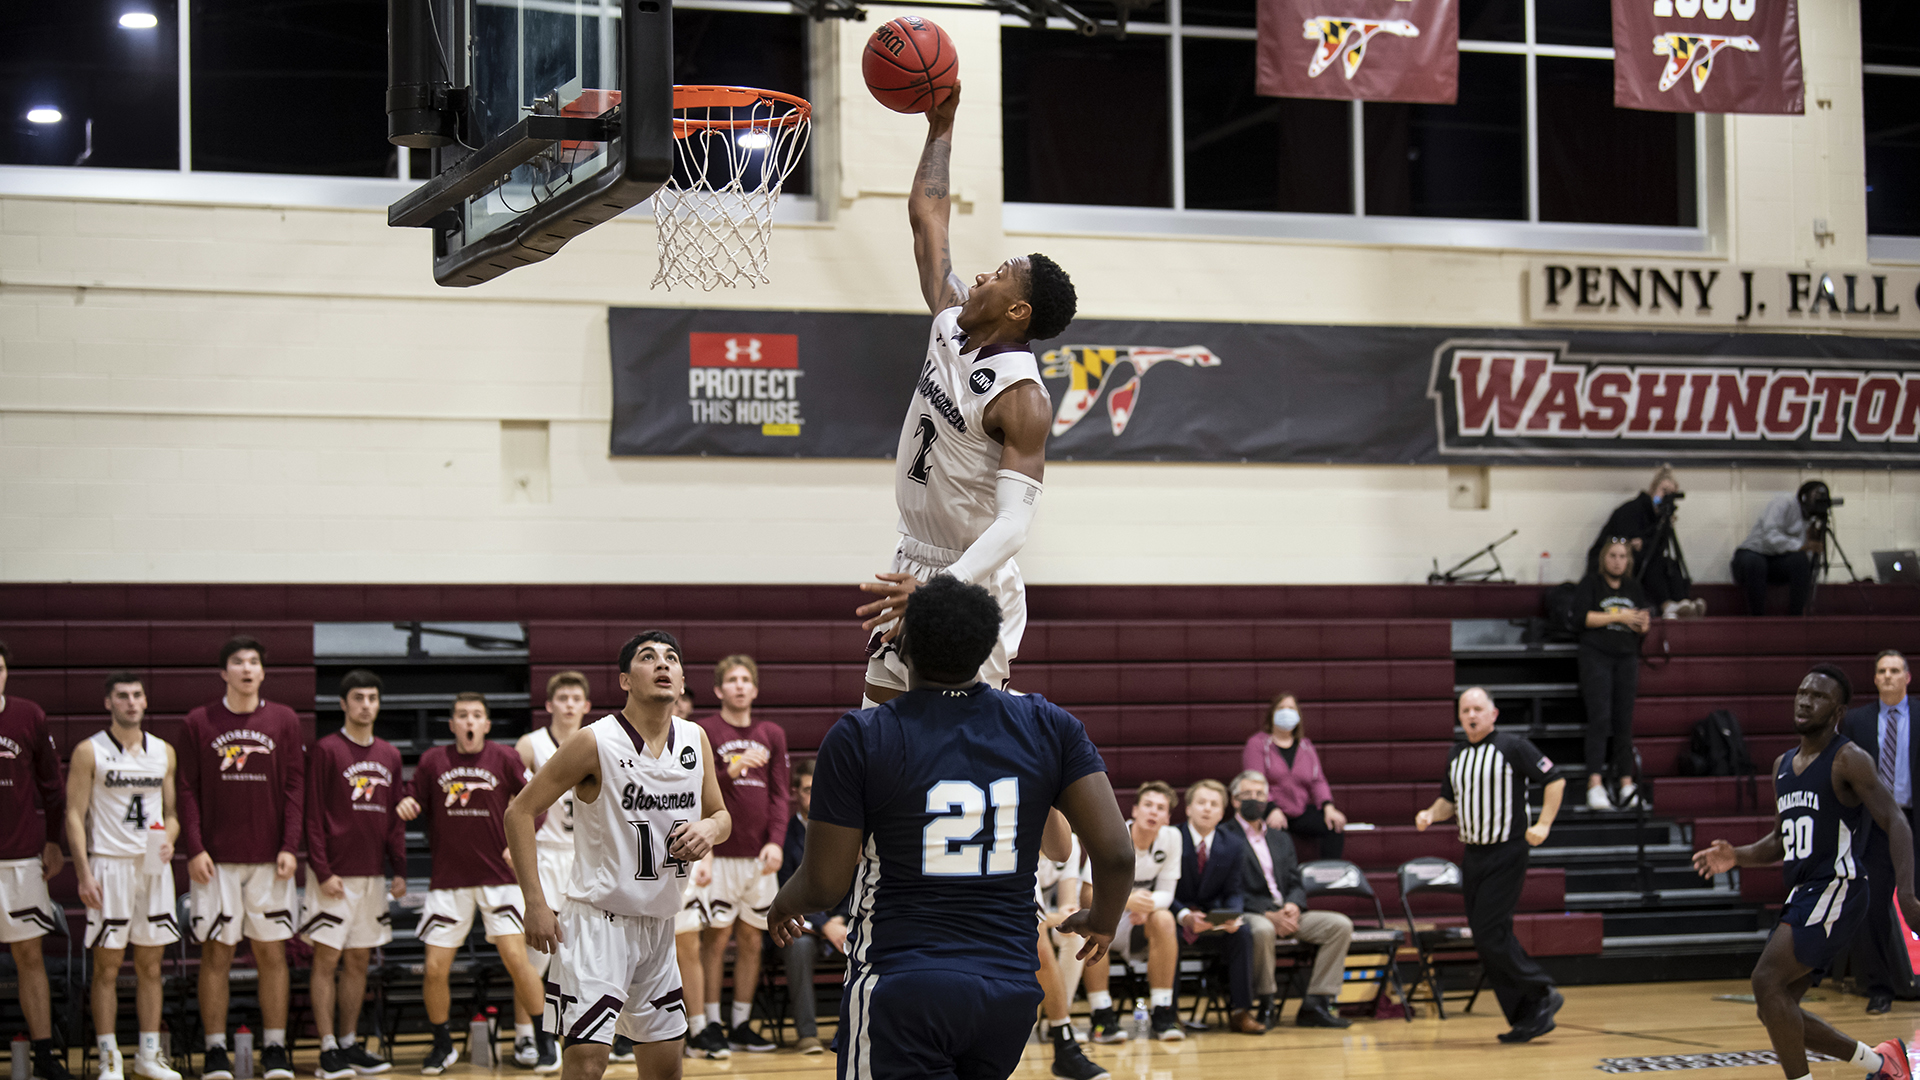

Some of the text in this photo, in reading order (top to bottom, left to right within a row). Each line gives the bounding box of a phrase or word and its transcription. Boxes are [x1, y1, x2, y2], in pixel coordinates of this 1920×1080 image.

[876, 25, 906, 58] Wil
[1545, 265, 1720, 310] PENNY
[1736, 271, 1766, 321] J.
[1786, 271, 1899, 315] FALL
[689, 368, 799, 399] PROTECT
[917, 359, 968, 434] Shoremen
[972, 371, 994, 391] JNW
[689, 400, 733, 424] THIS
[907, 413, 939, 487] 2
[210, 729, 276, 751] SHOREMEN
[717, 739, 770, 760] SHOREMN
[437, 766, 499, 788] SHOREMEN
[123, 793, 150, 832] 4
[621, 782, 697, 812] Shoremen
[922, 776, 1020, 877] 21
[1781, 815, 1815, 862] 20
[626, 819, 690, 881] 14
